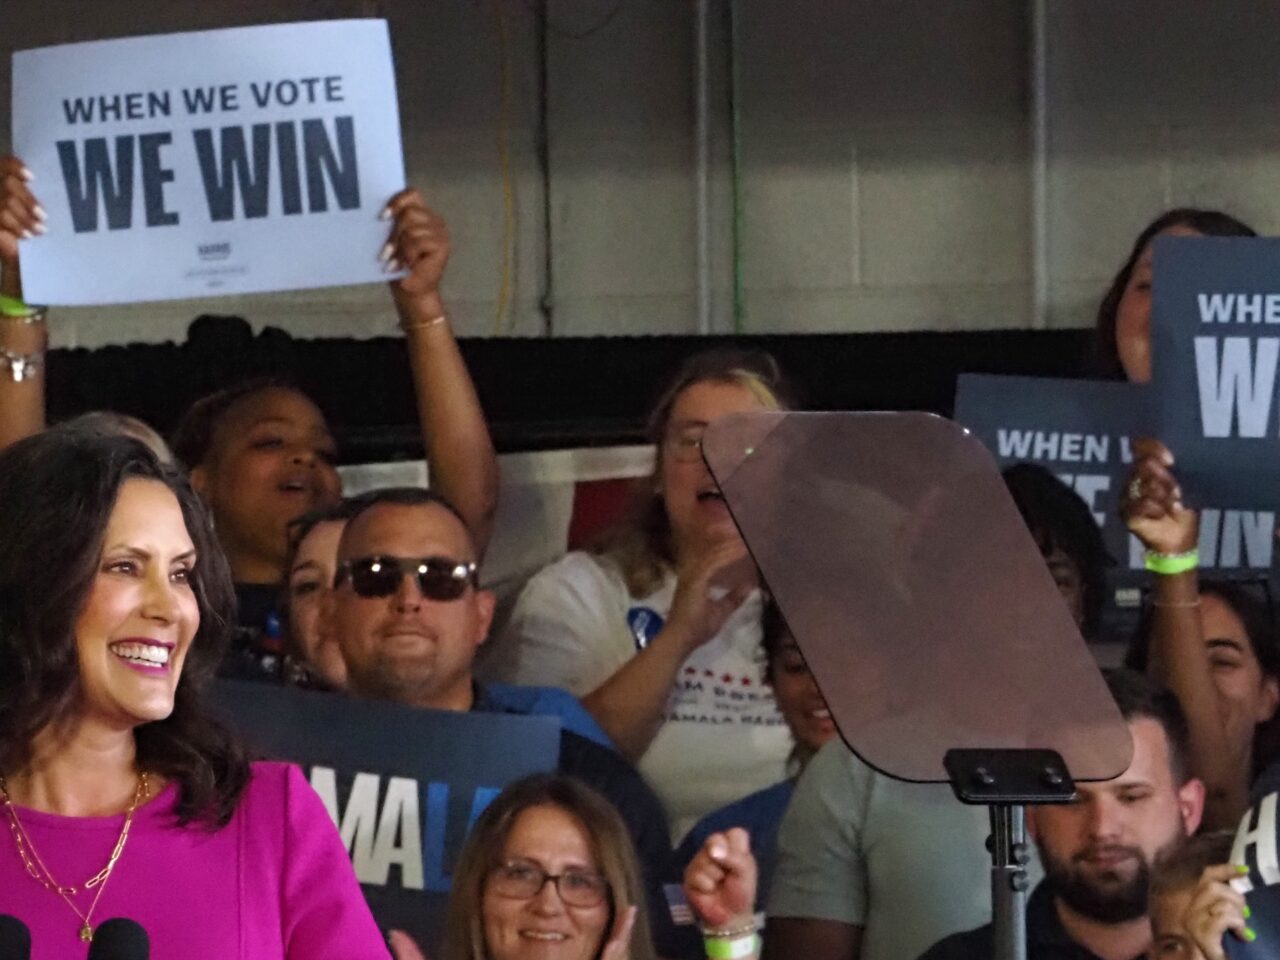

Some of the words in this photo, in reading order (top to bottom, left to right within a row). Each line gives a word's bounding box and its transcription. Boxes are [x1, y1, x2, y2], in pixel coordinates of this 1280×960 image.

[63, 91, 171, 124] WHEN
[182, 85, 240, 114] WE
[250, 76, 344, 108] VOTE
[55, 132, 180, 233] WE
[192, 116, 361, 222] WIN
[1194, 336, 1280, 438] W
[997, 429, 1110, 463] WHEN
[311, 766, 502, 892] MAL
